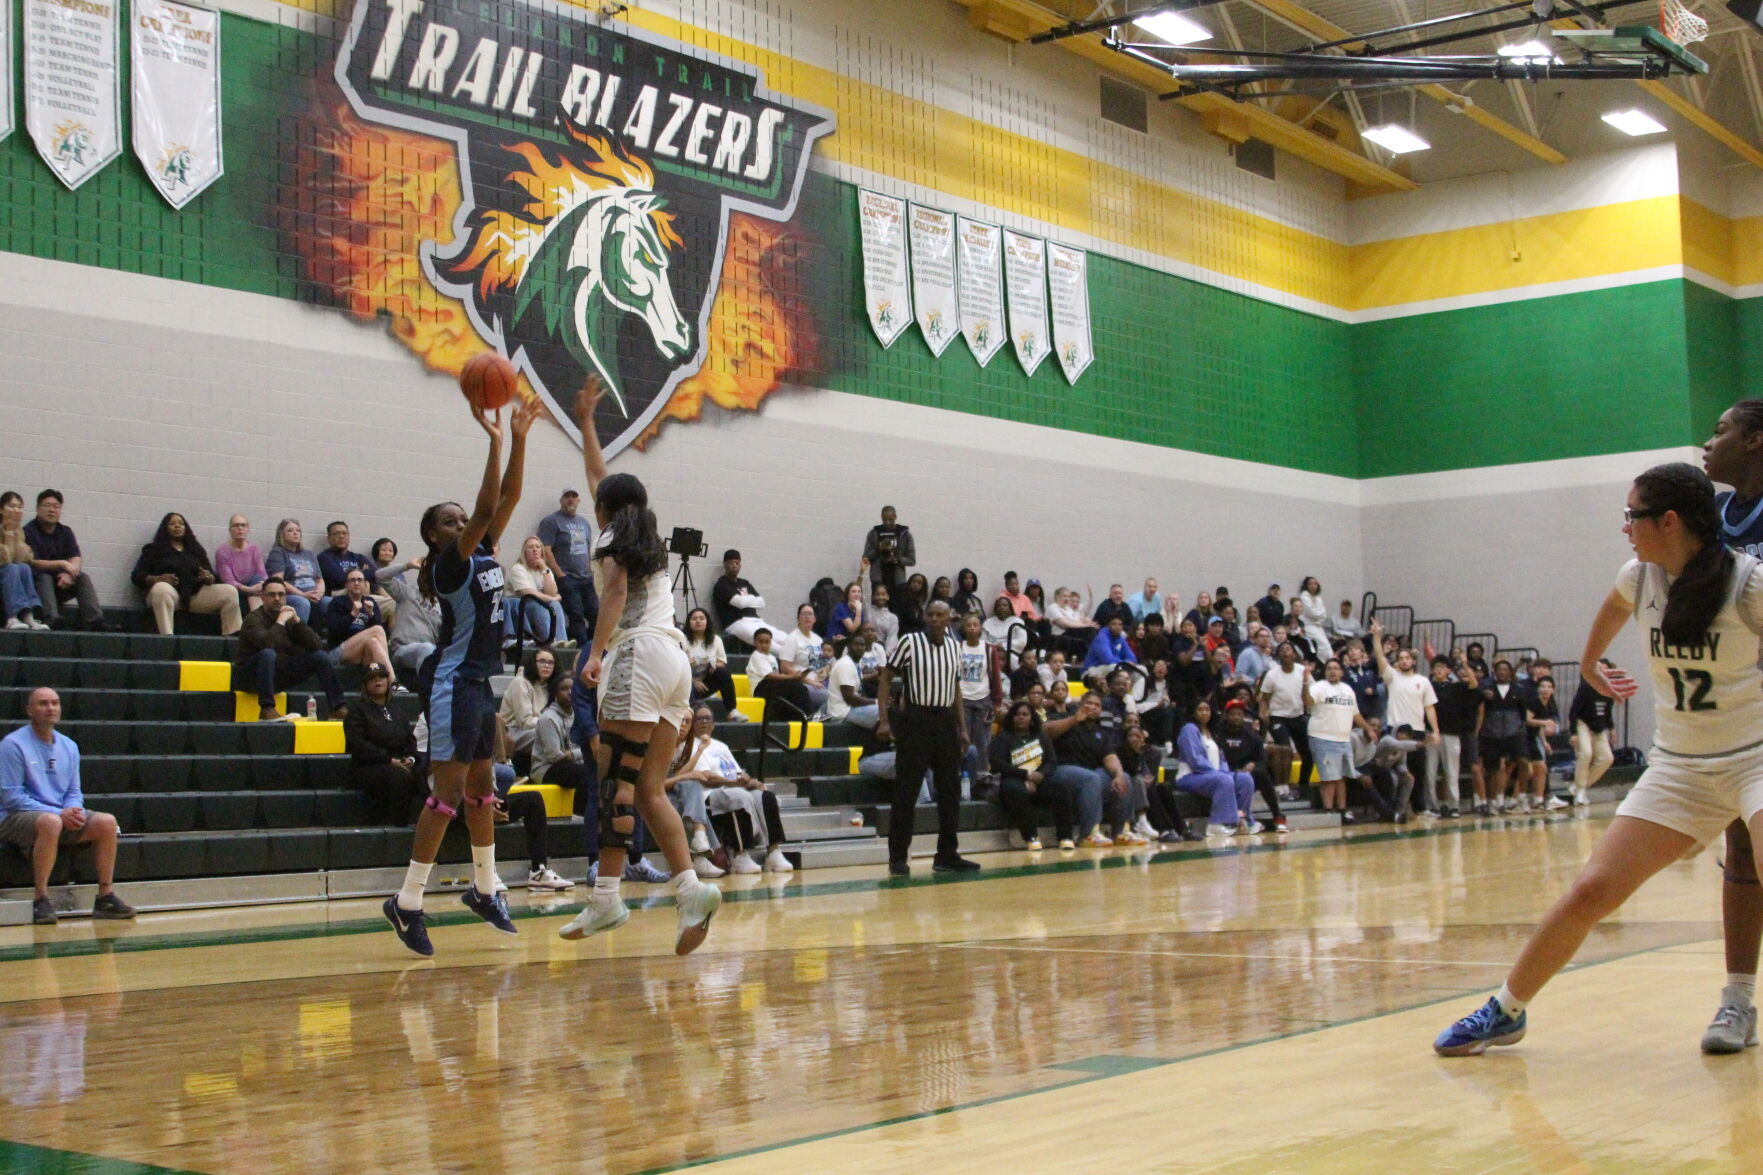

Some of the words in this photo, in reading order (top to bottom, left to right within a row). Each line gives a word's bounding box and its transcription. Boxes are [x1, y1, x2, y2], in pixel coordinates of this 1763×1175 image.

[370, 0, 544, 118] TRAIL
[553, 63, 786, 182] BLAZERS
[656, 56, 752, 102] TRAIL
[1667, 667, 1717, 712] 12
